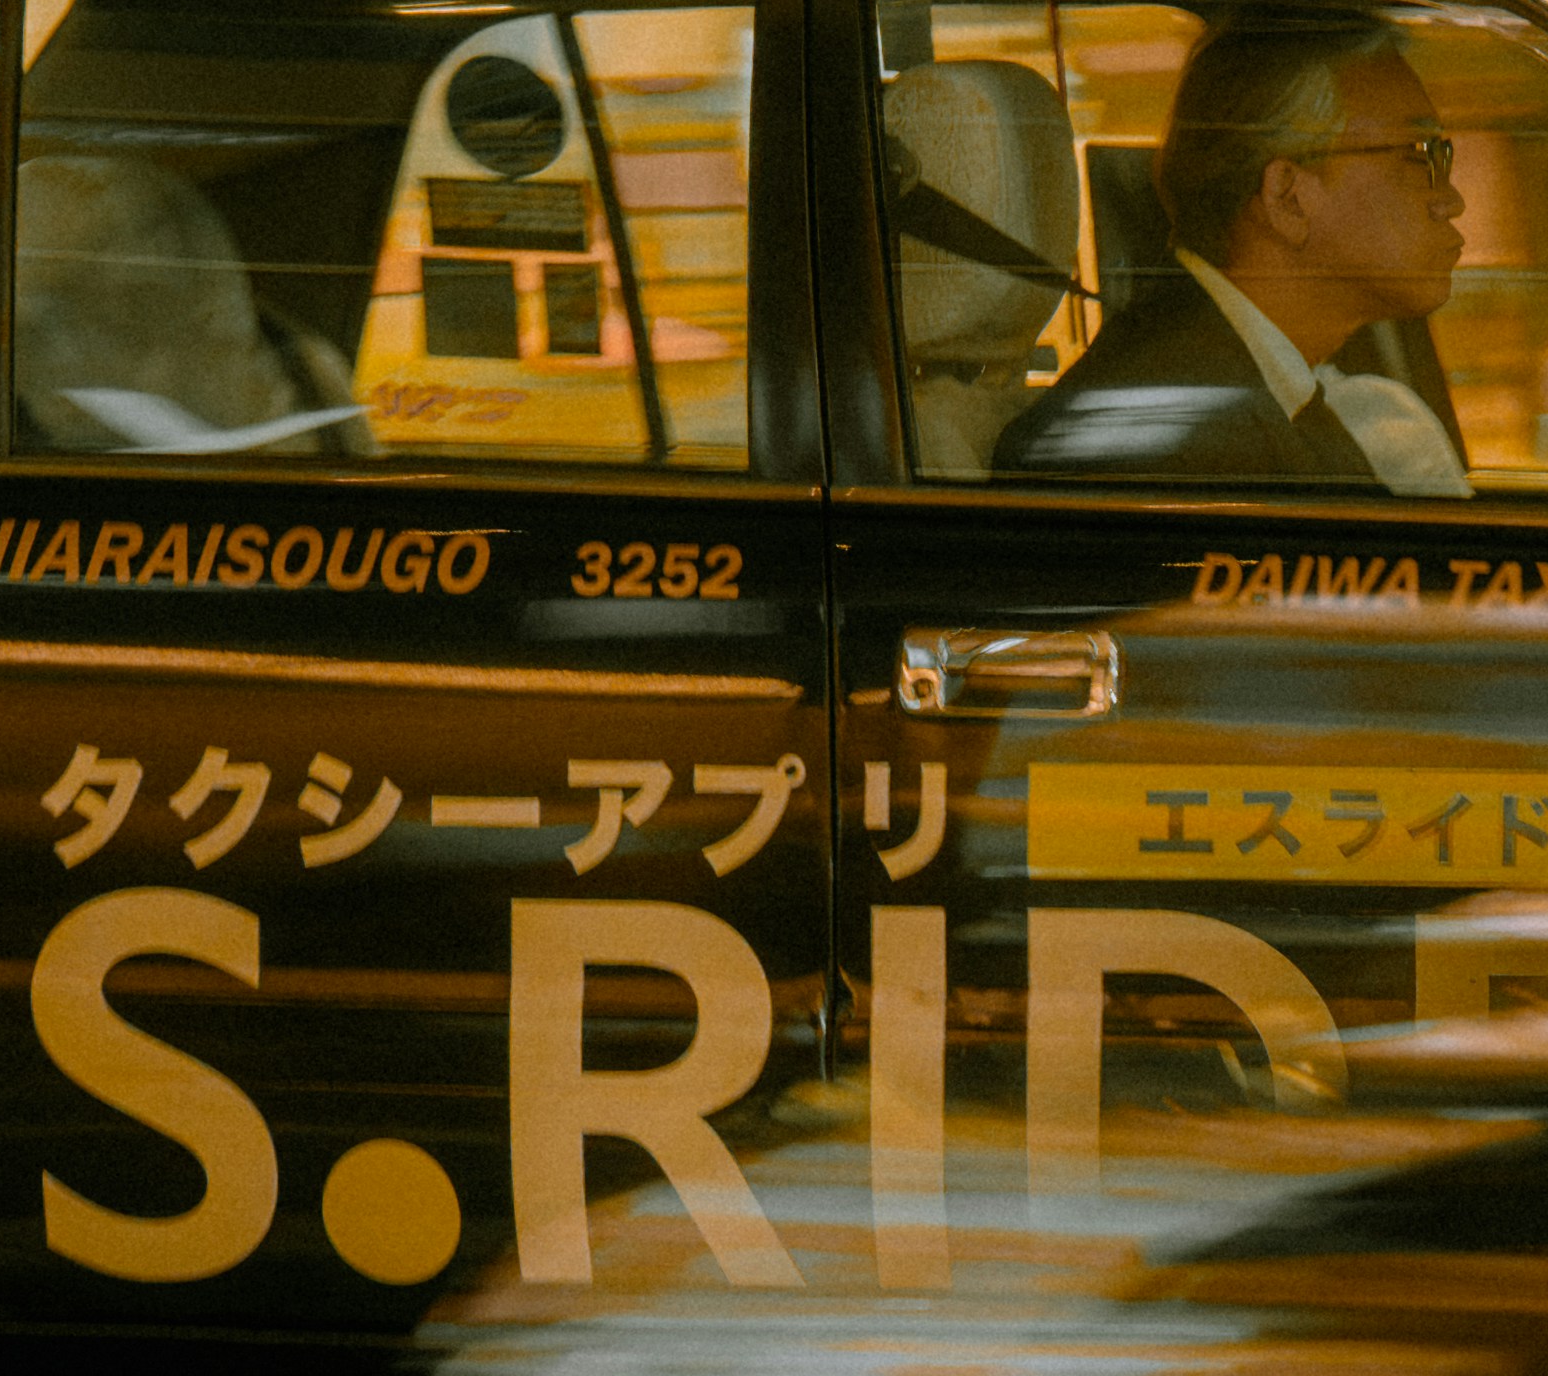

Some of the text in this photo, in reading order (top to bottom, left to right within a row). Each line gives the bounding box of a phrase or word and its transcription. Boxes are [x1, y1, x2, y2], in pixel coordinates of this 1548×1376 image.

[570, 540, 743, 601] 3252
[1192, 552, 1422, 608] DAIWA
[40, 742, 948, 883] タクシーアプリ
